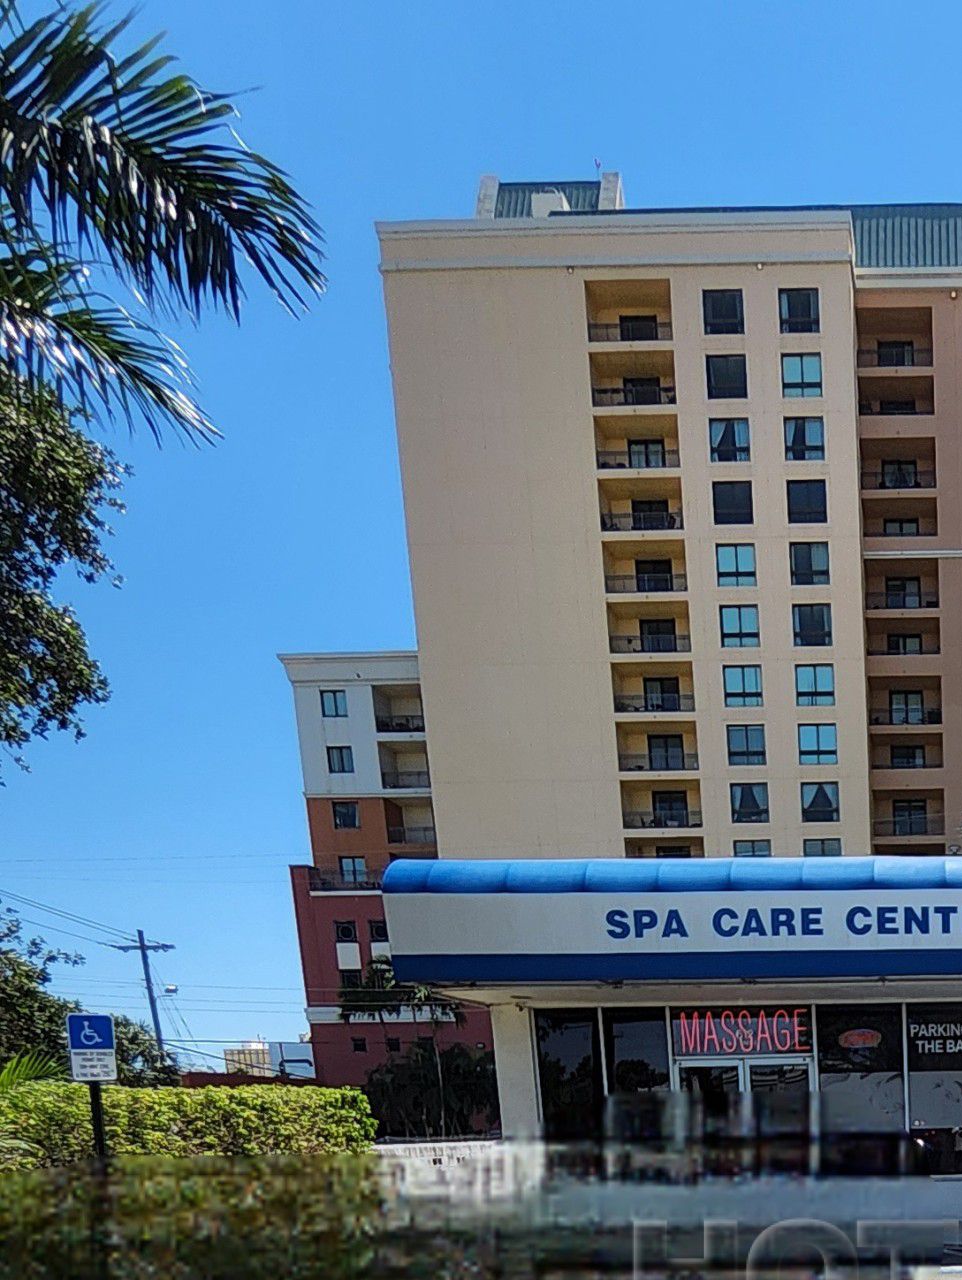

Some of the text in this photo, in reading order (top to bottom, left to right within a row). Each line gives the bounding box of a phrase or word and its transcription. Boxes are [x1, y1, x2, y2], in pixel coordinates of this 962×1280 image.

[605, 908, 690, 940] SPA
[712, 906, 825, 938] CARE
[680, 1008, 811, 1053] MASSAGE
[915, 1040, 944, 1054] THE
